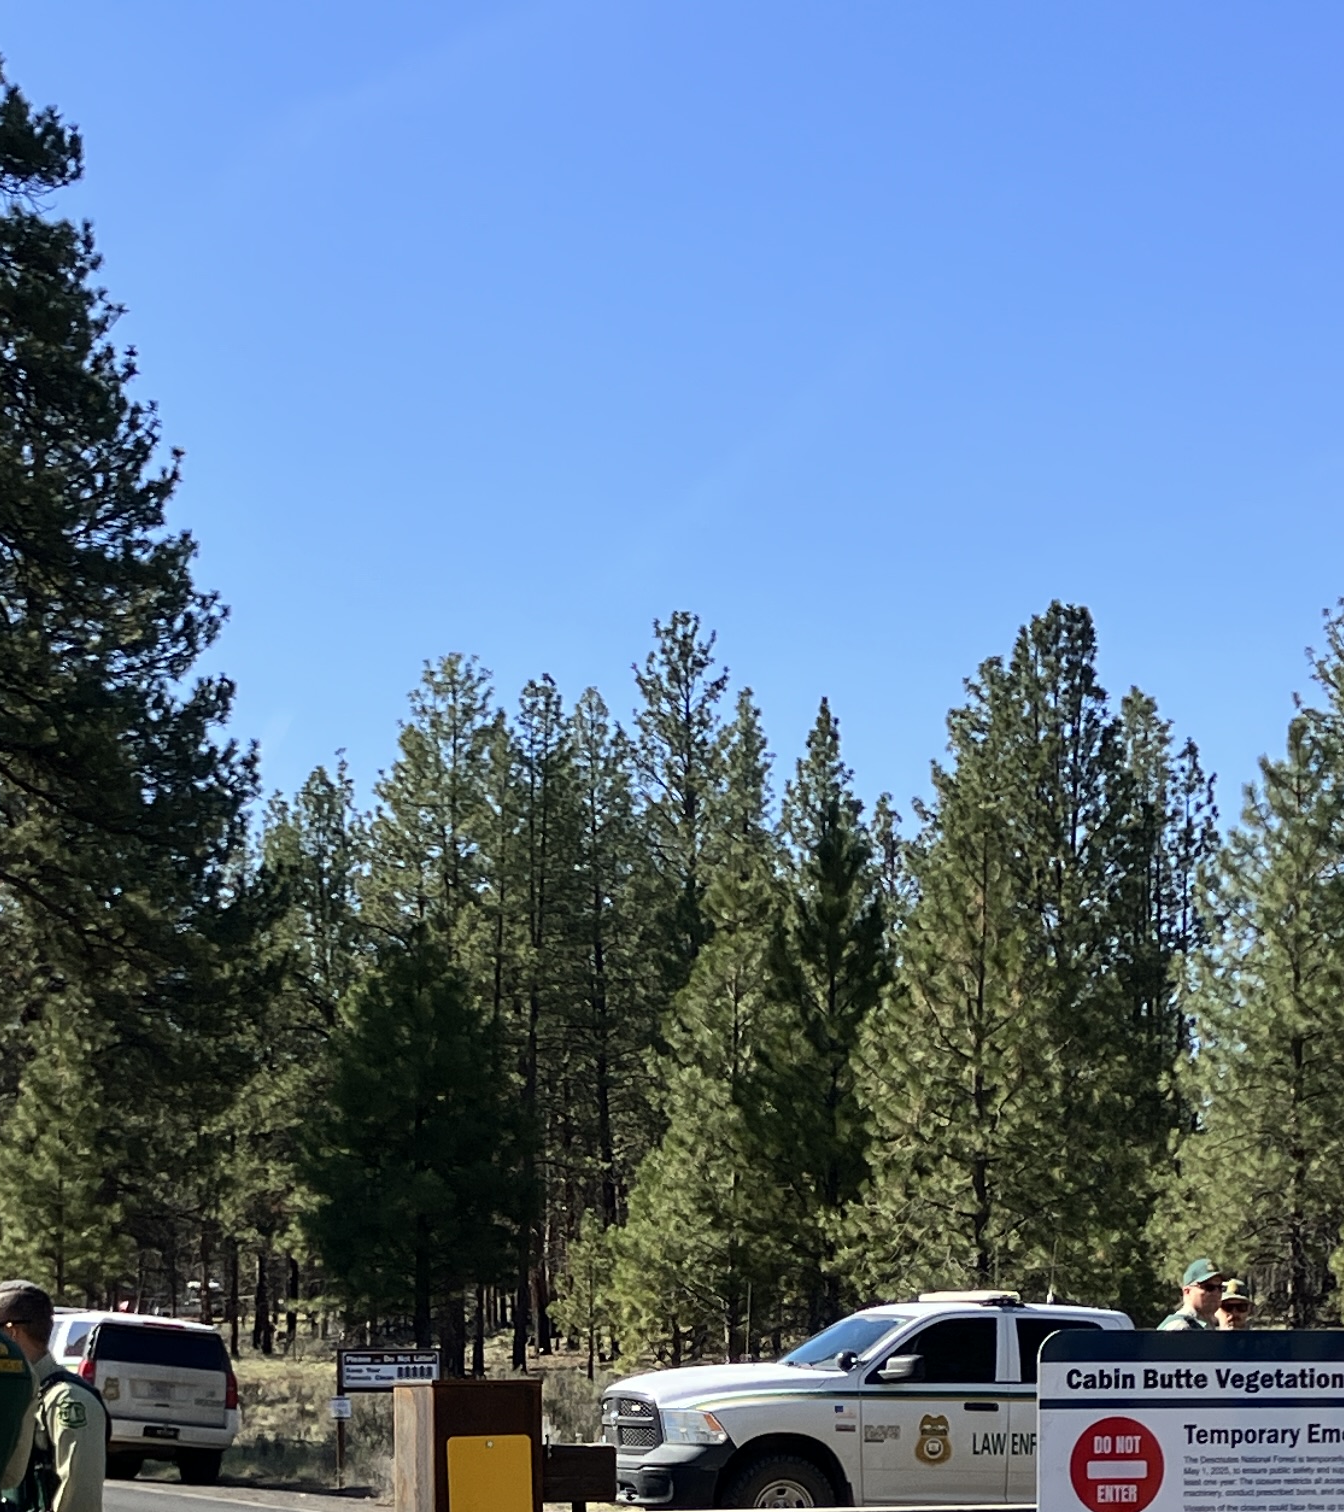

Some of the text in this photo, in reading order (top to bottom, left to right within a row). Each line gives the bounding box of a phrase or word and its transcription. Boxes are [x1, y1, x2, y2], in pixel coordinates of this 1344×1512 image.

[1066, 1368, 1136, 1389] Cabin
[1143, 1368, 1208, 1389] Butte
[1215, 1367, 1344, 1393] Vegetation
[972, 1433, 1006, 1455] LAW
[1093, 1435, 1141, 1454] DO NOT
[1183, 1423, 1301, 1448] Temporary
[1097, 1484, 1137, 1503] ENTER
